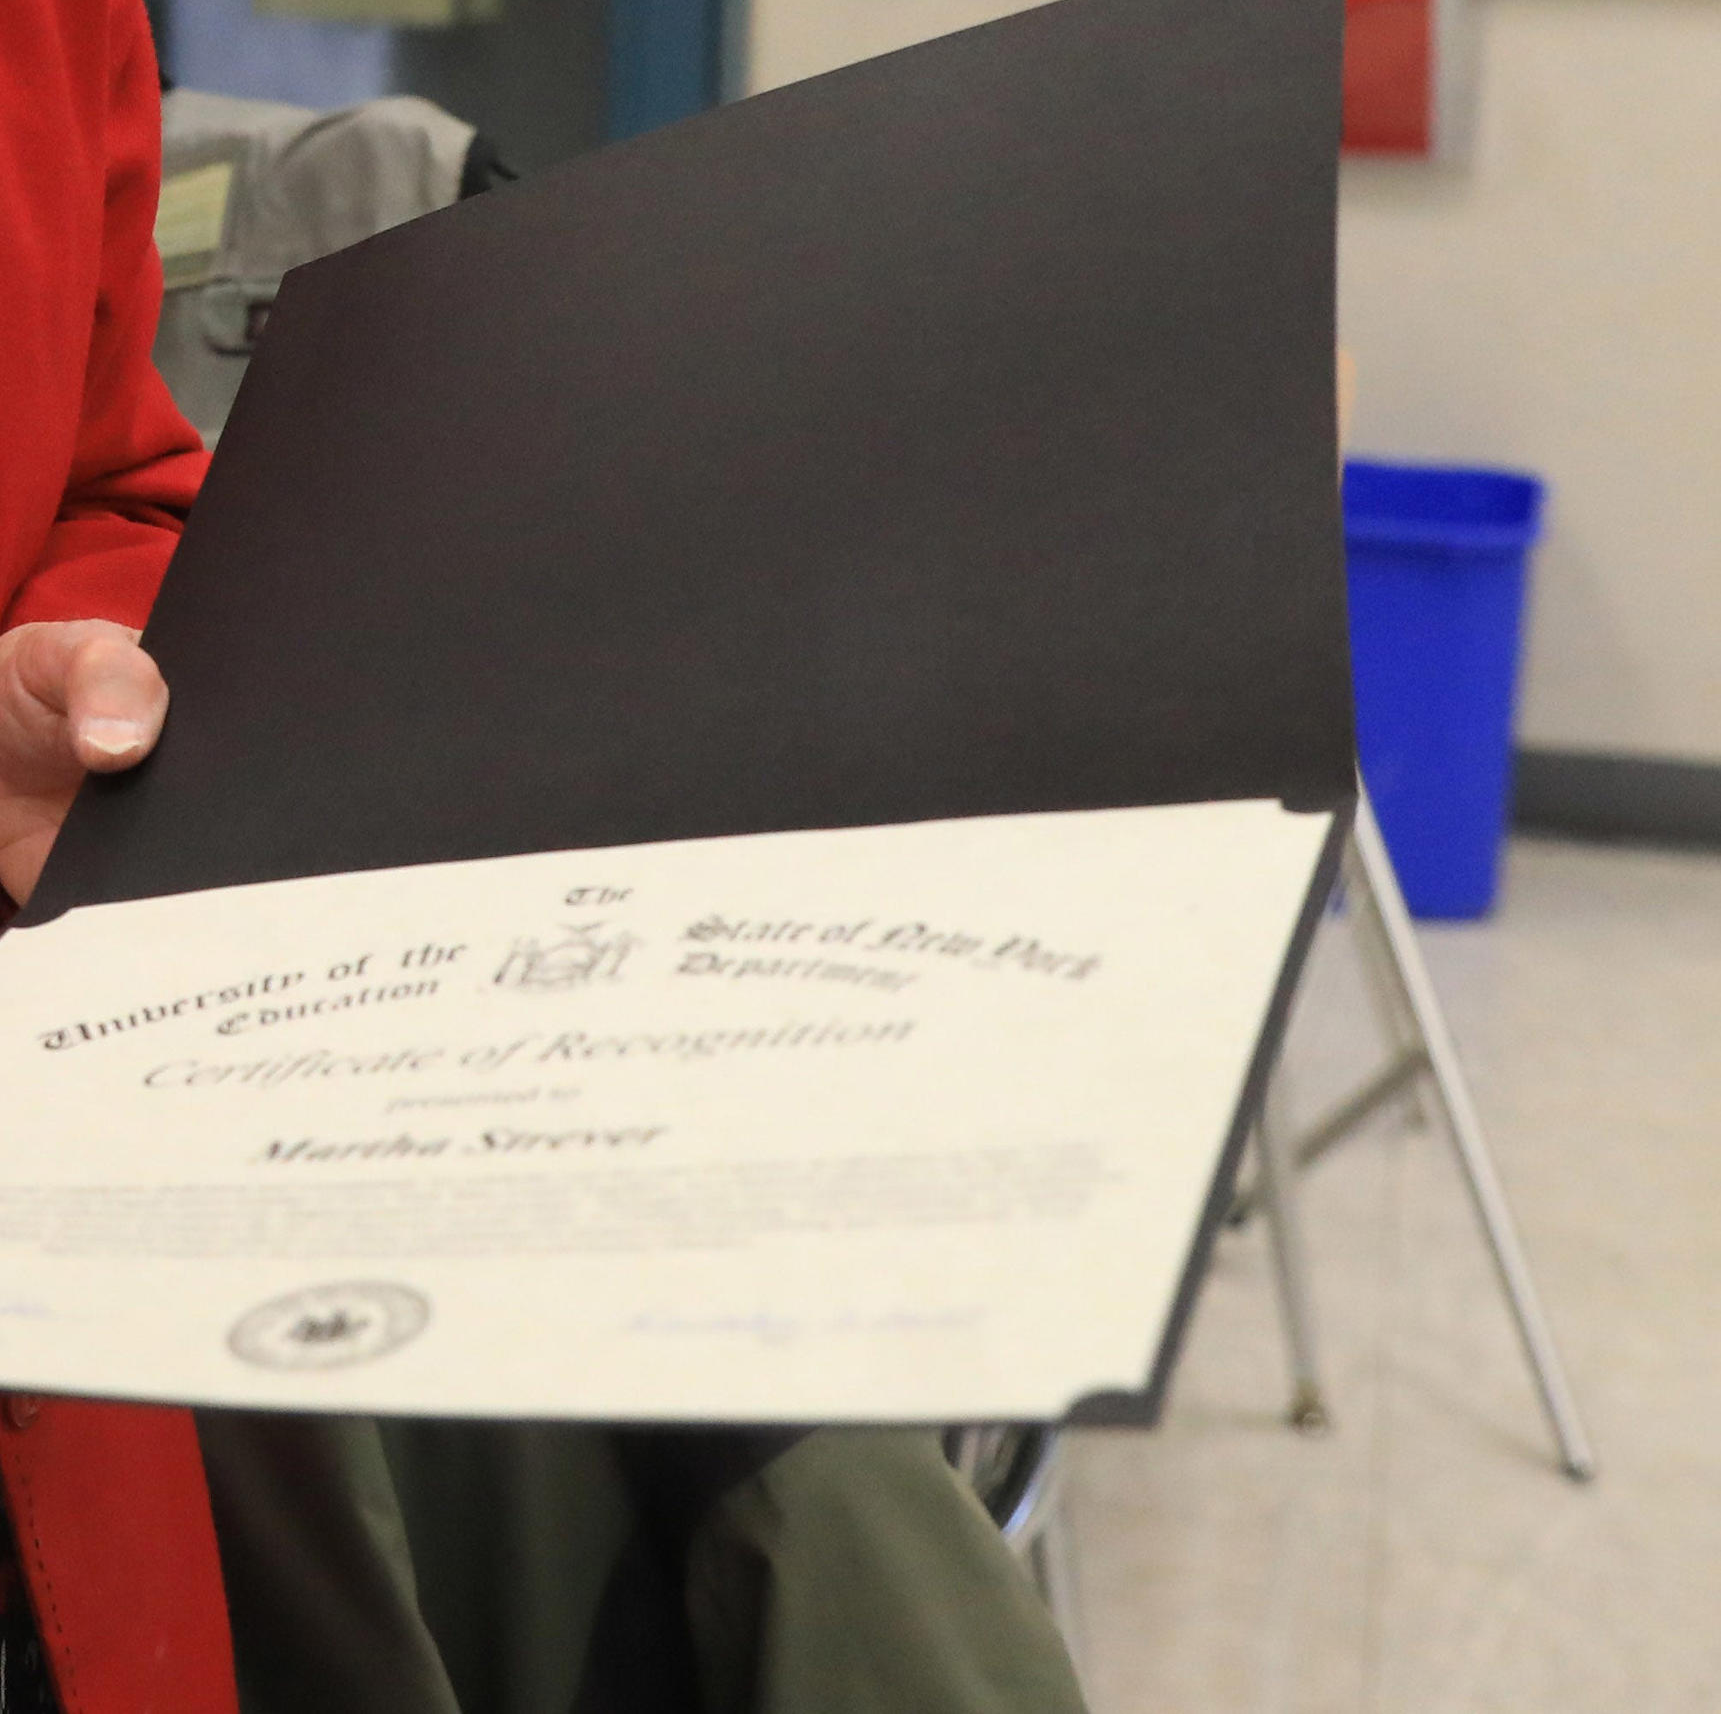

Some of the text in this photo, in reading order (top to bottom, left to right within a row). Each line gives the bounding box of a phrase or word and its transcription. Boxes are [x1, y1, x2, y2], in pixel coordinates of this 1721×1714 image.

[562, 885, 635, 906] The
[676, 949, 922, 992] Department
[678, 913, 1105, 982] State of New York
[36, 941, 470, 1053] University of the
[215, 978, 442, 1038] Education
[140, 1020, 920, 1093] Certificate of Recognition
[254, 1129, 450, 1167] Martha
